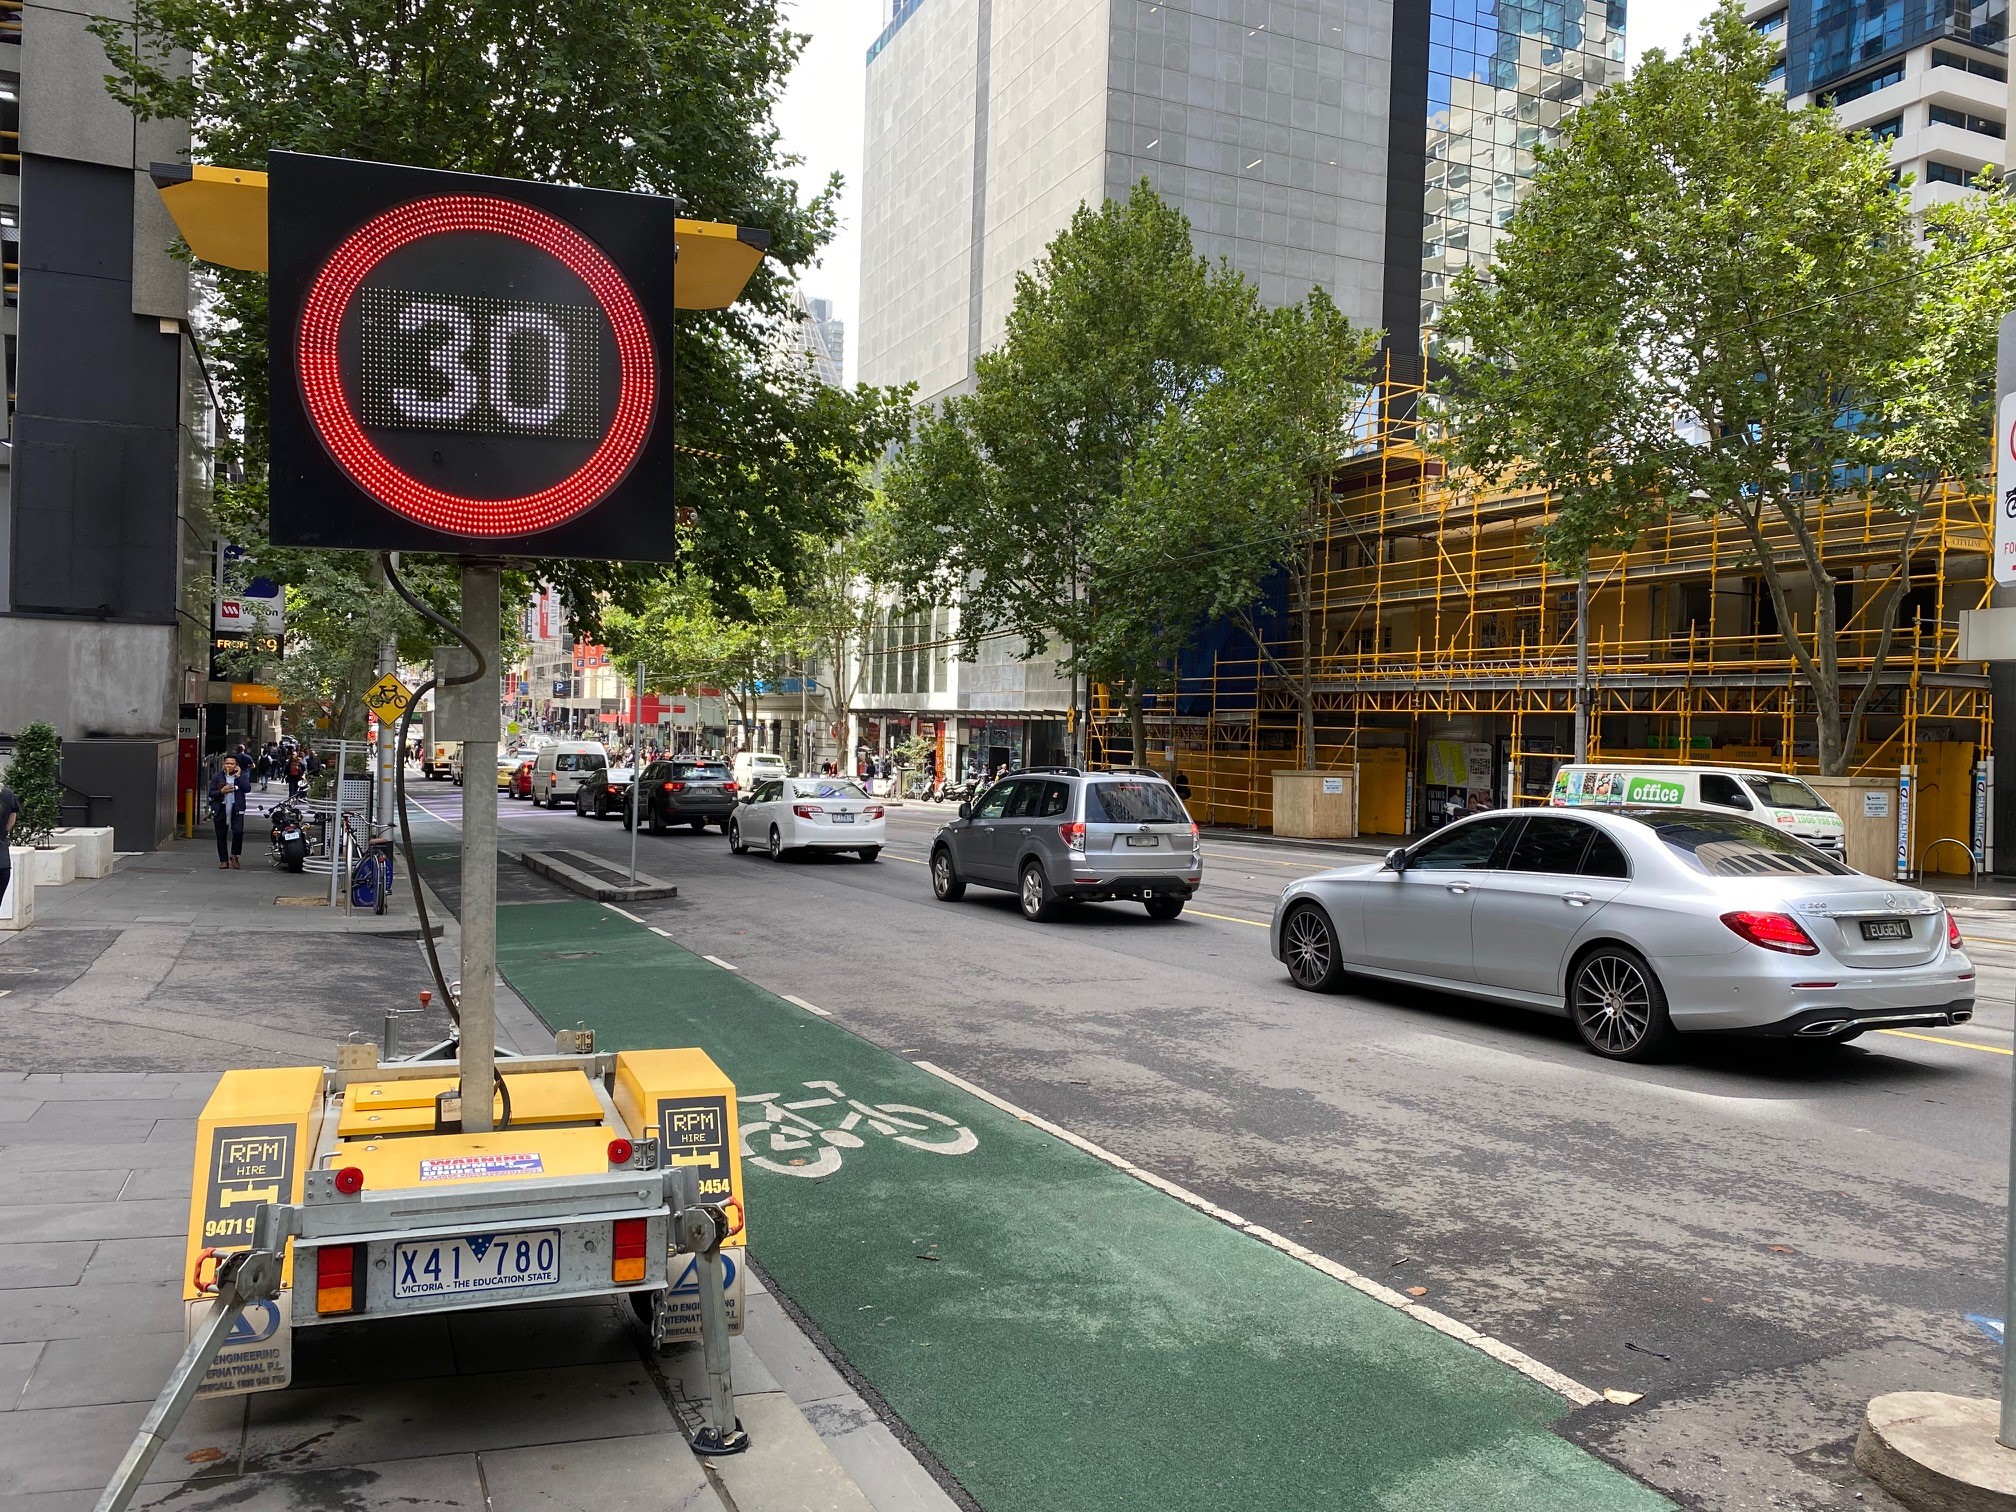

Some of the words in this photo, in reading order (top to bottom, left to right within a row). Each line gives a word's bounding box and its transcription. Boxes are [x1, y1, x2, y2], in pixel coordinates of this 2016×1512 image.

[392, 300, 567, 426] 30
[1952, 538, 1982, 547] CITYLINE
[242, 604, 278, 617] Won
[556, 683, 563, 692] P
[1633, 783, 1679, 802] office
[1901, 801, 1909, 845] CITYLINE
[1976, 795, 1985, 838] CITYLINE
[1869, 922, 1906, 937] EUGENI
[673, 1112, 714, 1132] RPM
[681, 1133, 706, 1143] HIRE
[229, 1142, 279, 1163] RPM
[429, 1154, 532, 1166] WARNING
[236, 1165, 267, 1175] HIRE
[422, 1167, 487, 1176] UNDER
[205, 1218, 242, 1237] 9471
[401, 1246, 460, 1285] X41
[493, 1238, 554, 1276] 780
[401, 1282, 444, 1294] VICTORIA
[453, 1279, 471, 1289] THE
[473, 1274, 525, 1287] EDUCATION
[527, 1272, 552, 1282] STATE
[665, 1327, 697, 1336] REECALL
[212, 1348, 280, 1366] ENGINEERING
[204, 1363, 265, 1380] ERNATIONAL
[196, 1381, 234, 1393] REECALL
